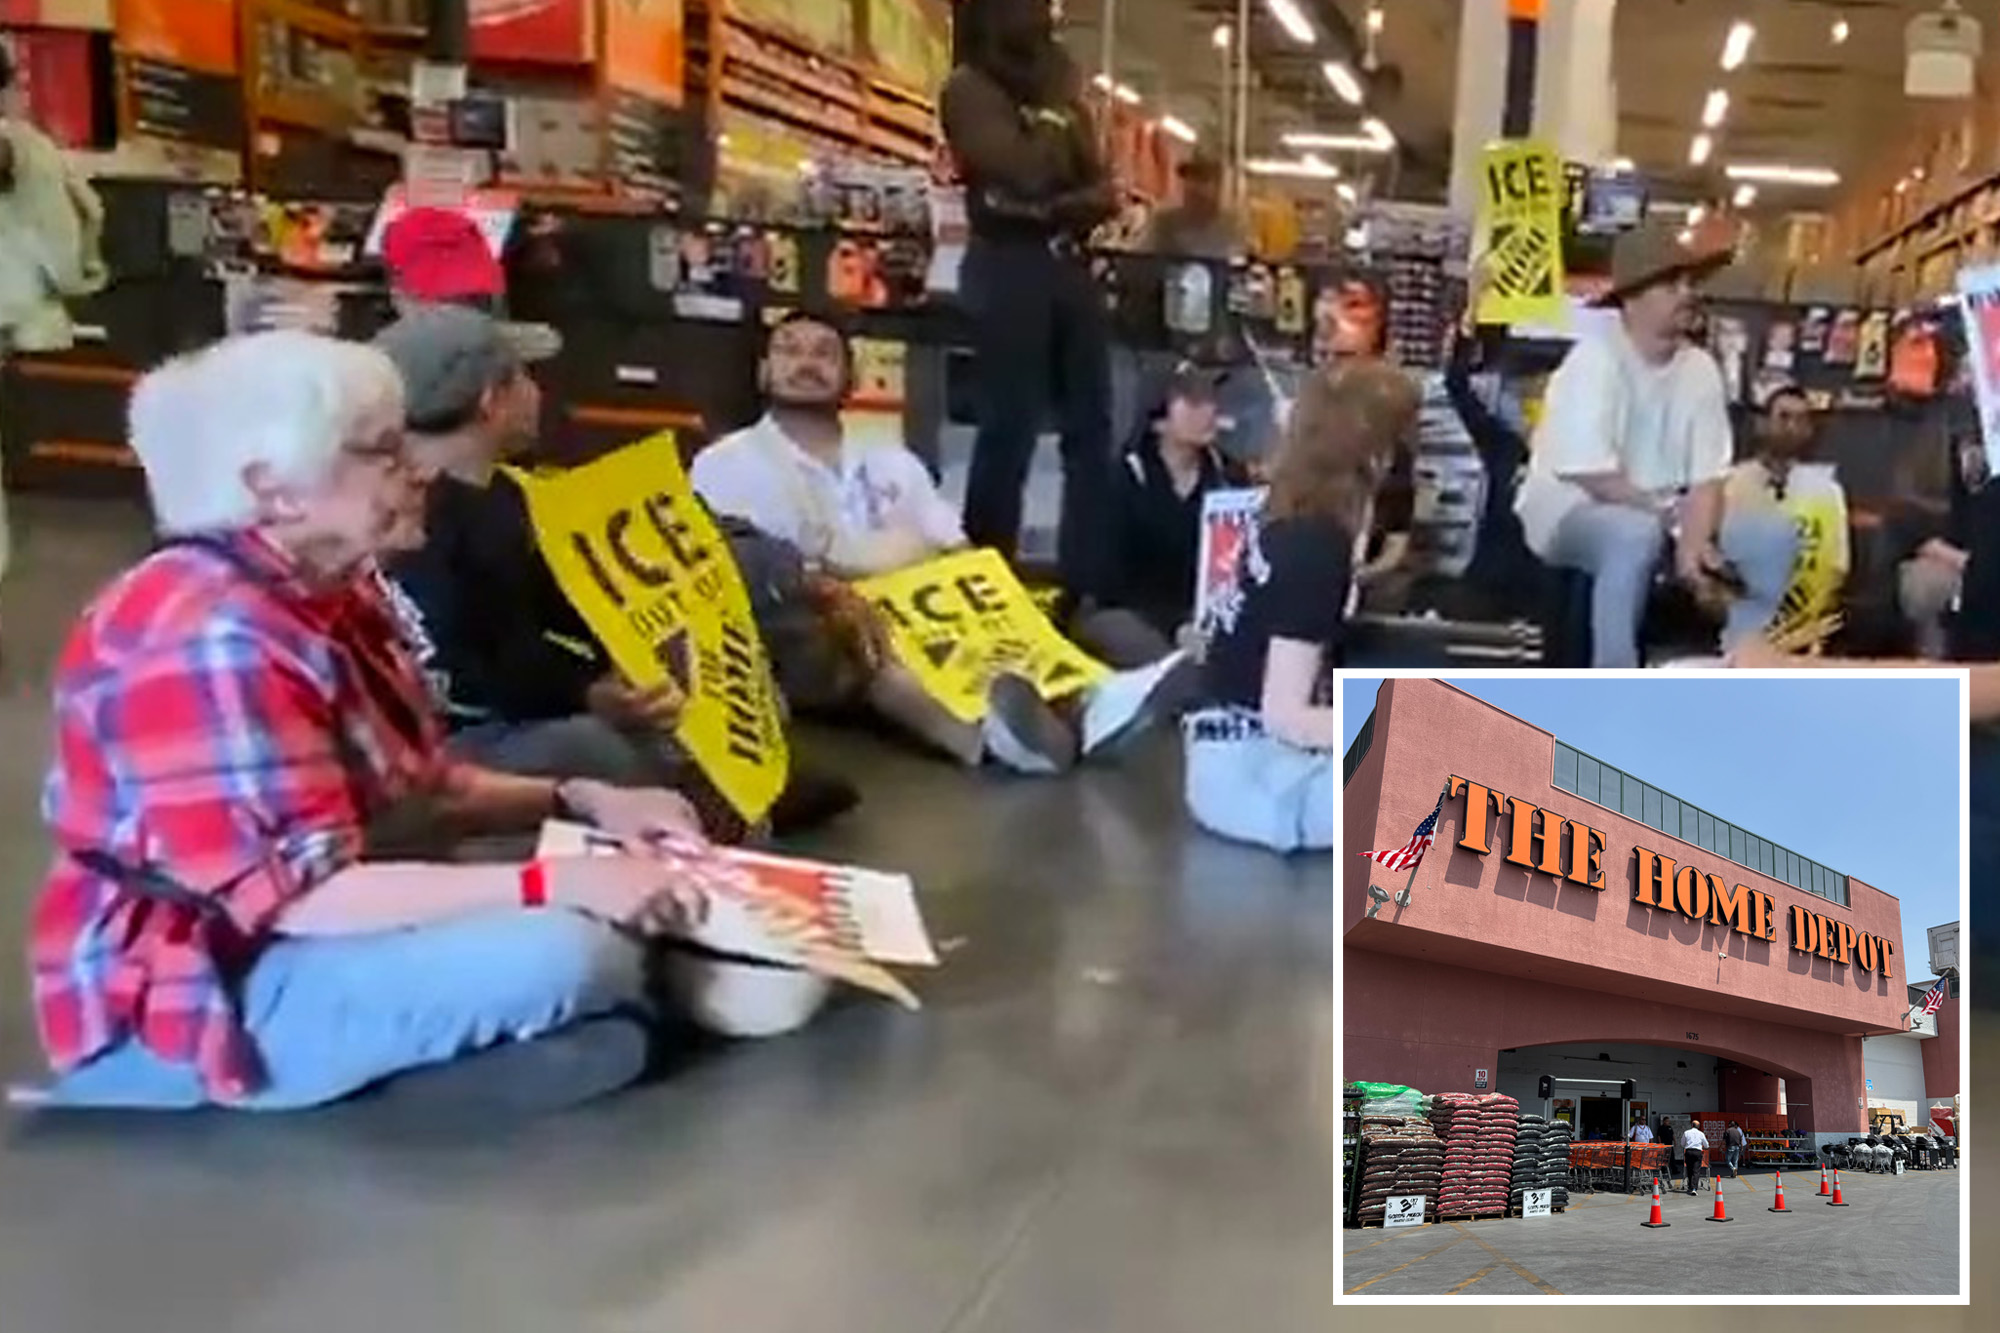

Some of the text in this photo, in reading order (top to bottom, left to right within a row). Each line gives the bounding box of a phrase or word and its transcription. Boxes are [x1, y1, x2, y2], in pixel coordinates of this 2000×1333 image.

[1488, 154, 1551, 204] ICE
[571, 492, 709, 609] ICE
[876, 572, 1008, 628] ICE
[1448, 774, 1895, 979] THE HOME DEPOT
[1685, 1031, 1699, 1041] 1675
[1477, 1070, 1486, 1078] 10
[1703, 1120, 1726, 1130] ORDER
